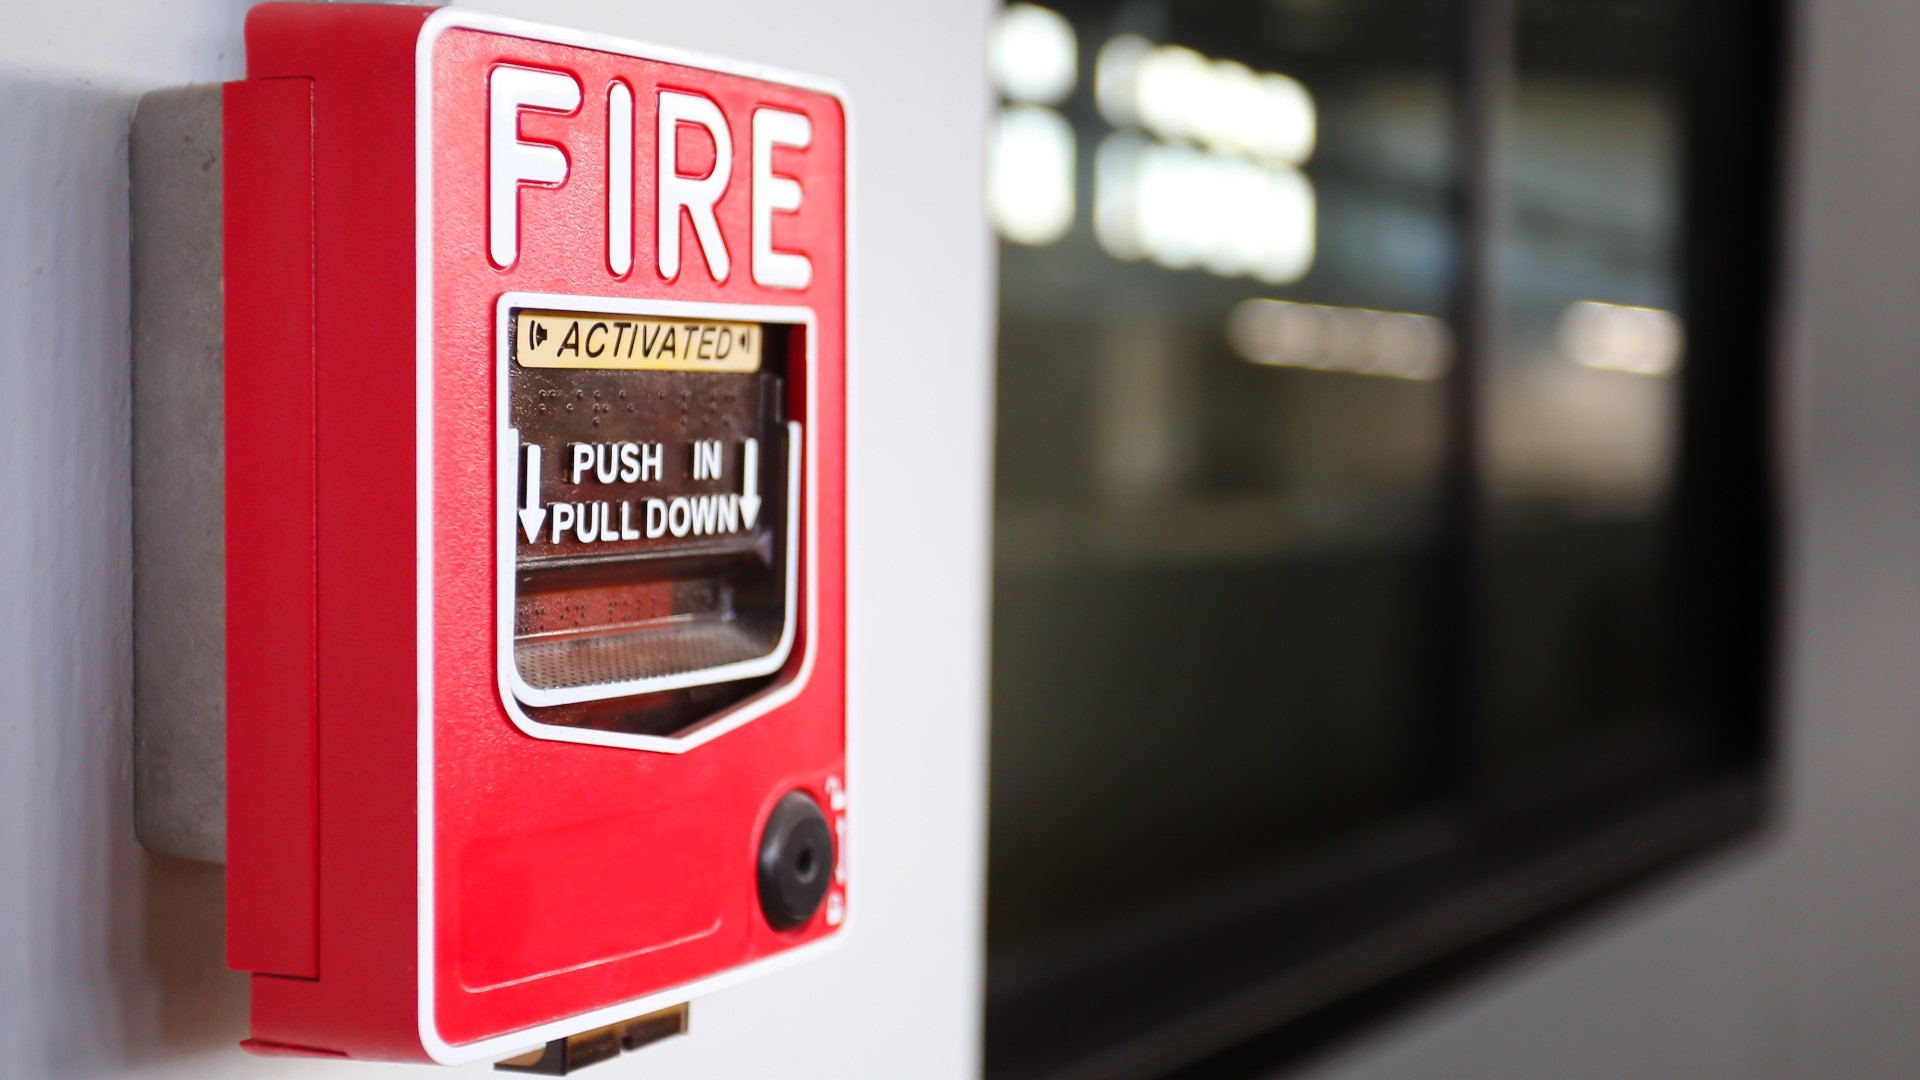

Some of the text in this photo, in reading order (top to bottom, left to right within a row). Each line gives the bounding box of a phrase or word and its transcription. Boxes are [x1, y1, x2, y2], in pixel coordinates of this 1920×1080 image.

[489, 65, 813, 290] FIRE
[556, 321, 733, 361] ACTIVATED
[573, 440, 722, 485] PUSH IN
[552, 494, 738, 544] PULL DOWN
